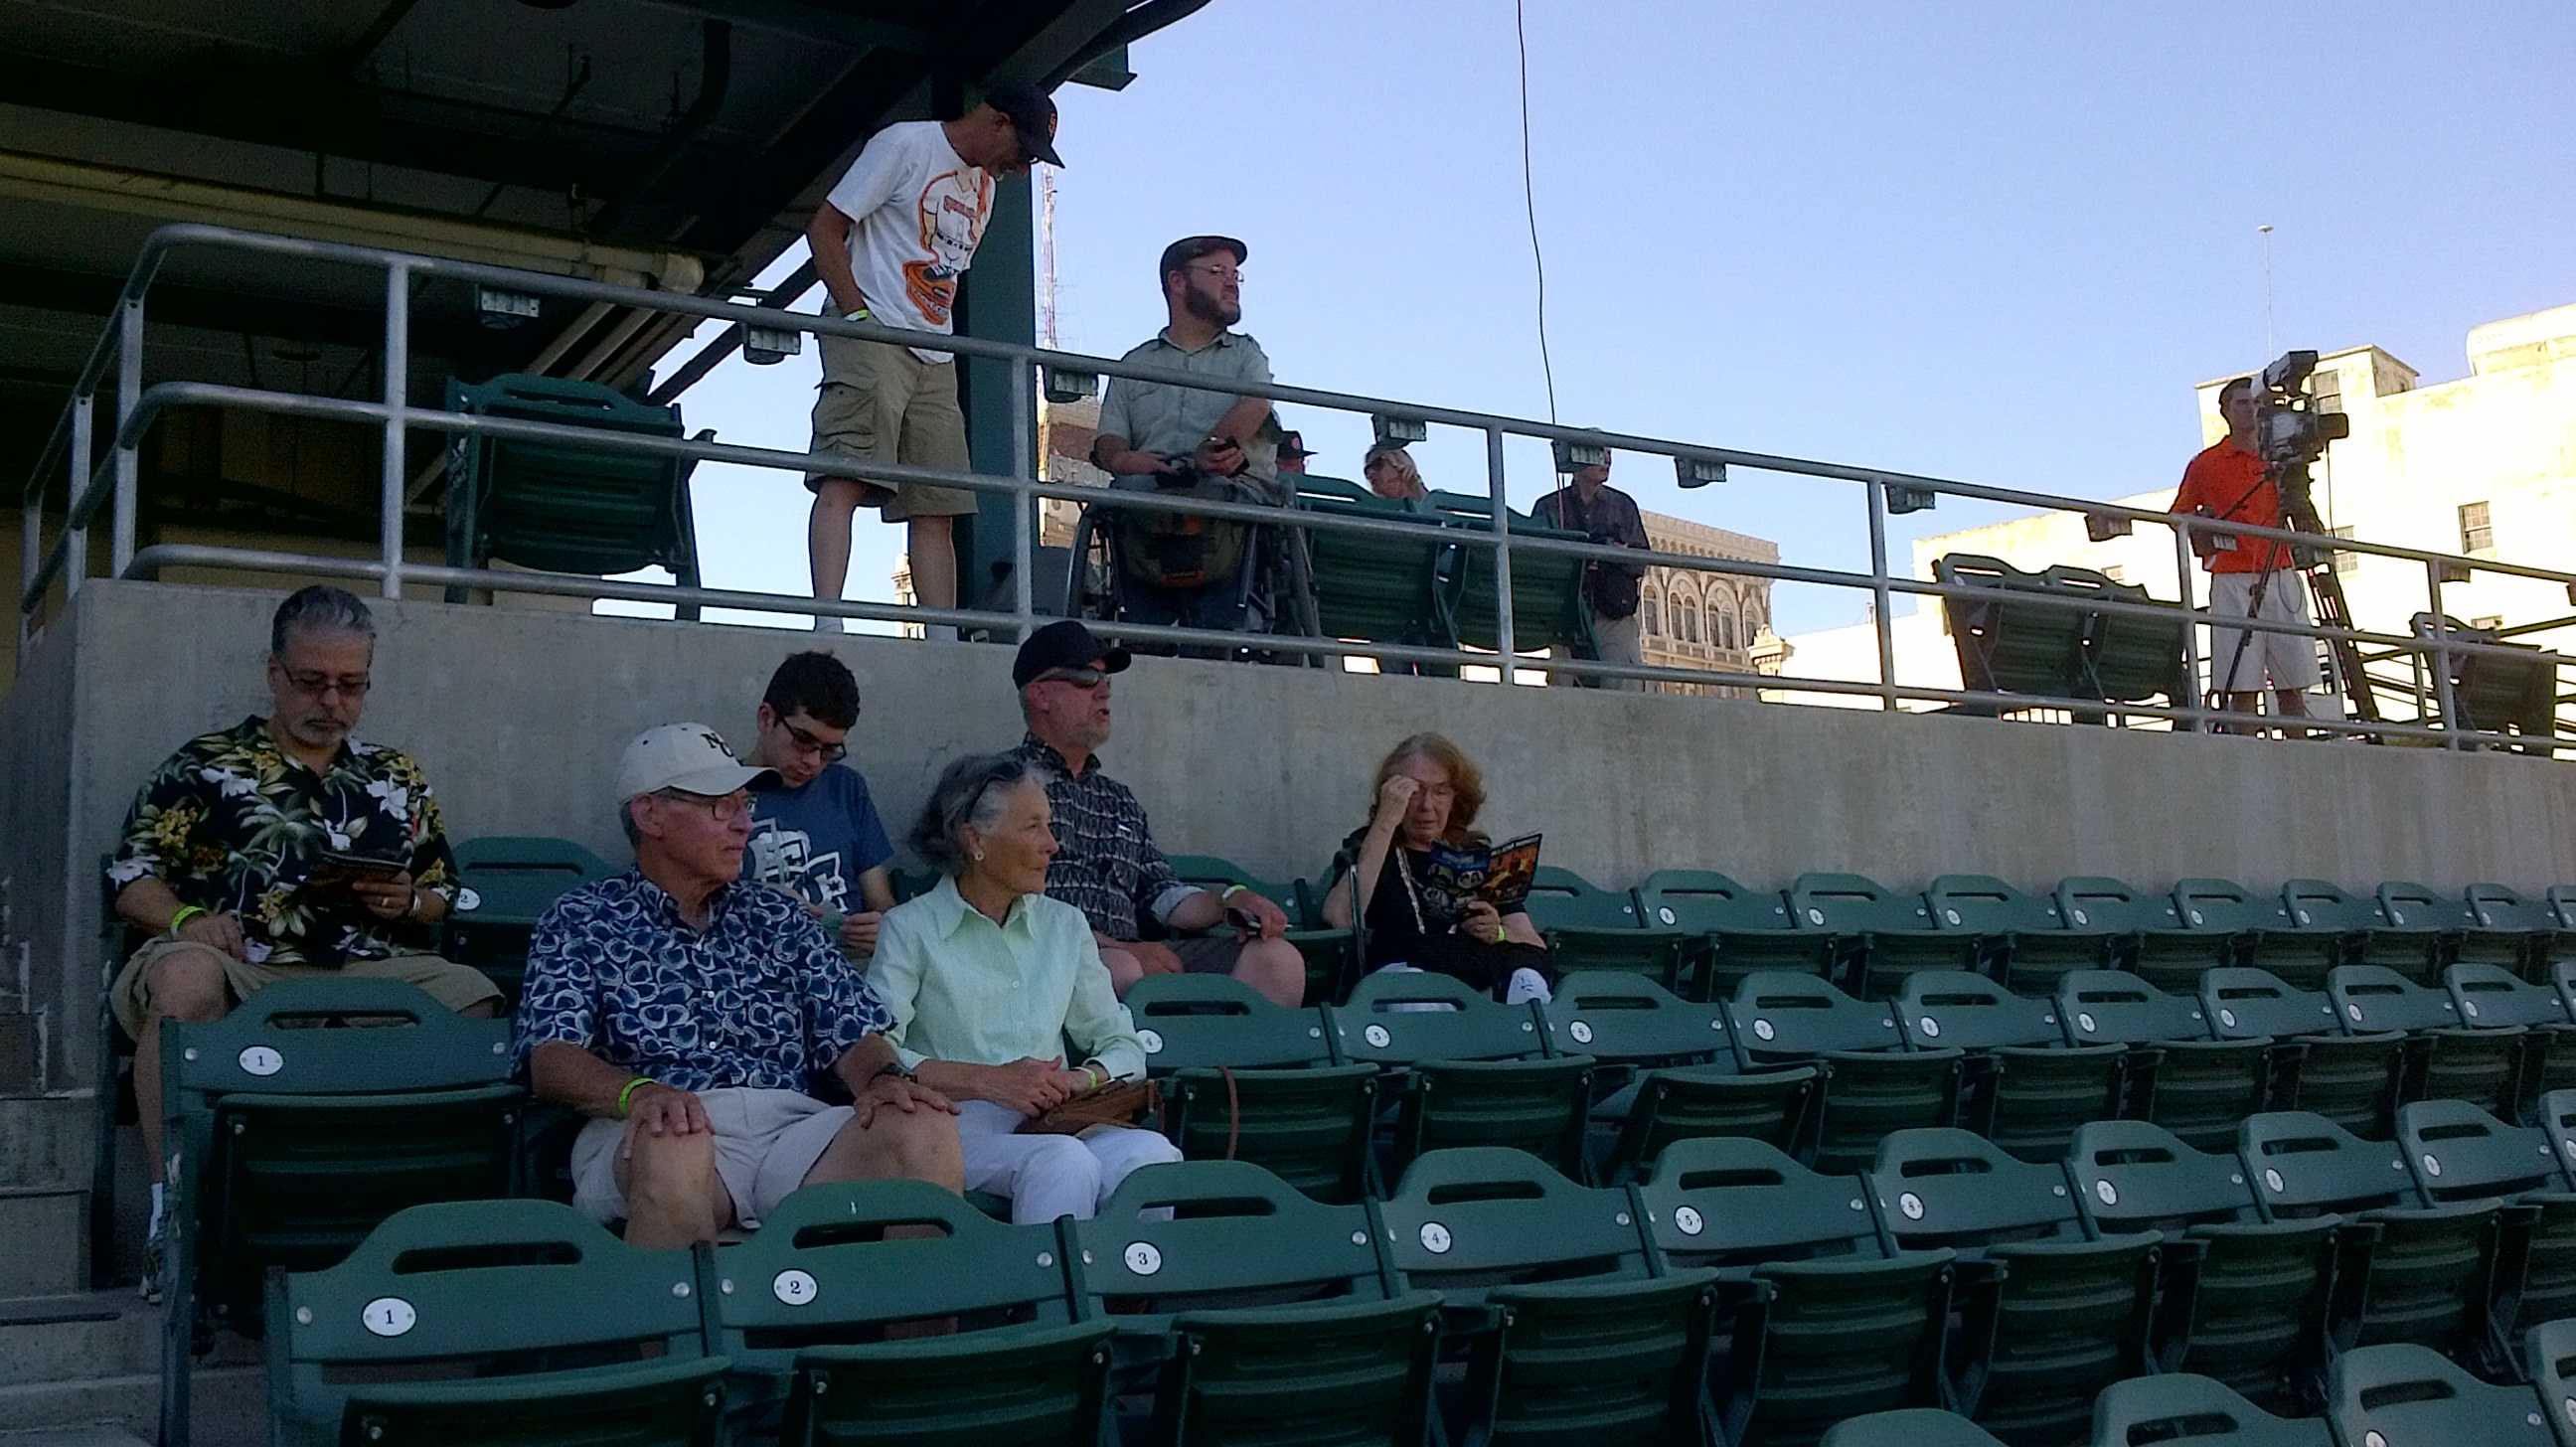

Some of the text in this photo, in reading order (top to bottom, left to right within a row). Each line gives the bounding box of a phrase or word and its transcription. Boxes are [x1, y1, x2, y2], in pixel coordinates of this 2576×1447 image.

[459, 893, 469, 904] 2
[1373, 1031, 1381, 1042] 5
[257, 1054, 265, 1067] 1
[1685, 1214, 1693, 1226] 5
[1431, 1232, 1440, 1245] 4
[1138, 1251, 1148, 1265] 3
[790, 1280, 801, 1295] 2
[385, 1309, 395, 1325] 1
